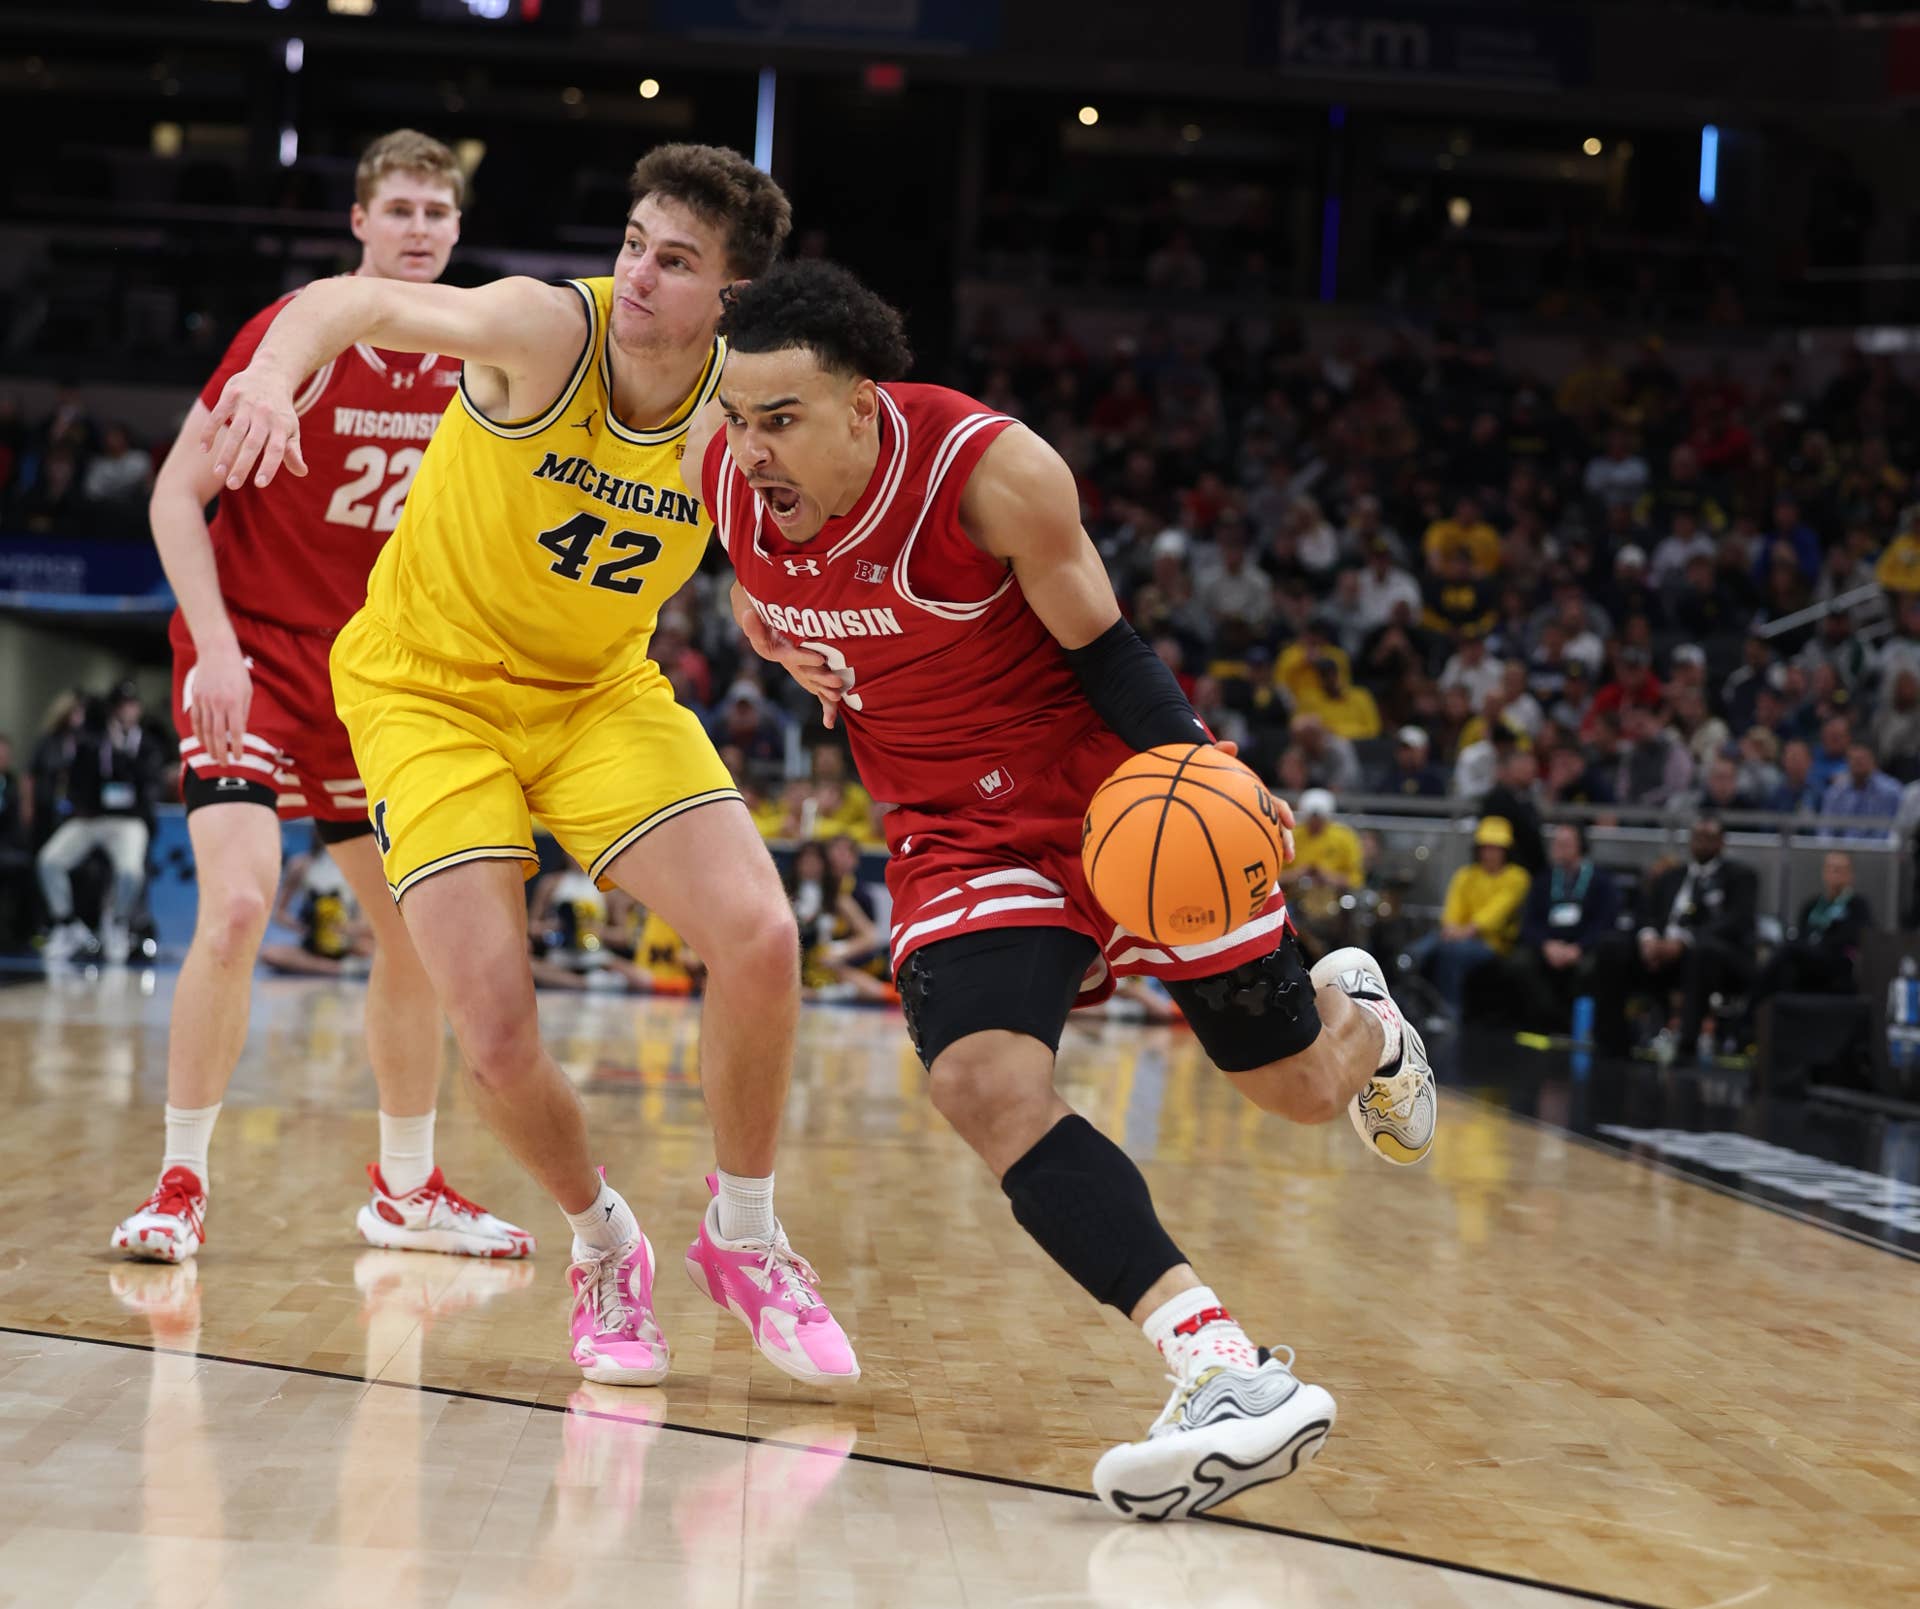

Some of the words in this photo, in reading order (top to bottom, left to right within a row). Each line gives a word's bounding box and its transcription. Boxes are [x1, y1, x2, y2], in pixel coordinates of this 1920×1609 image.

[334, 407, 443, 440] WISCONSI
[324, 445, 425, 532] 22
[532, 452, 701, 527] MICHIGAN
[537, 512, 663, 595] 42
[979, 769, 1002, 794] W
